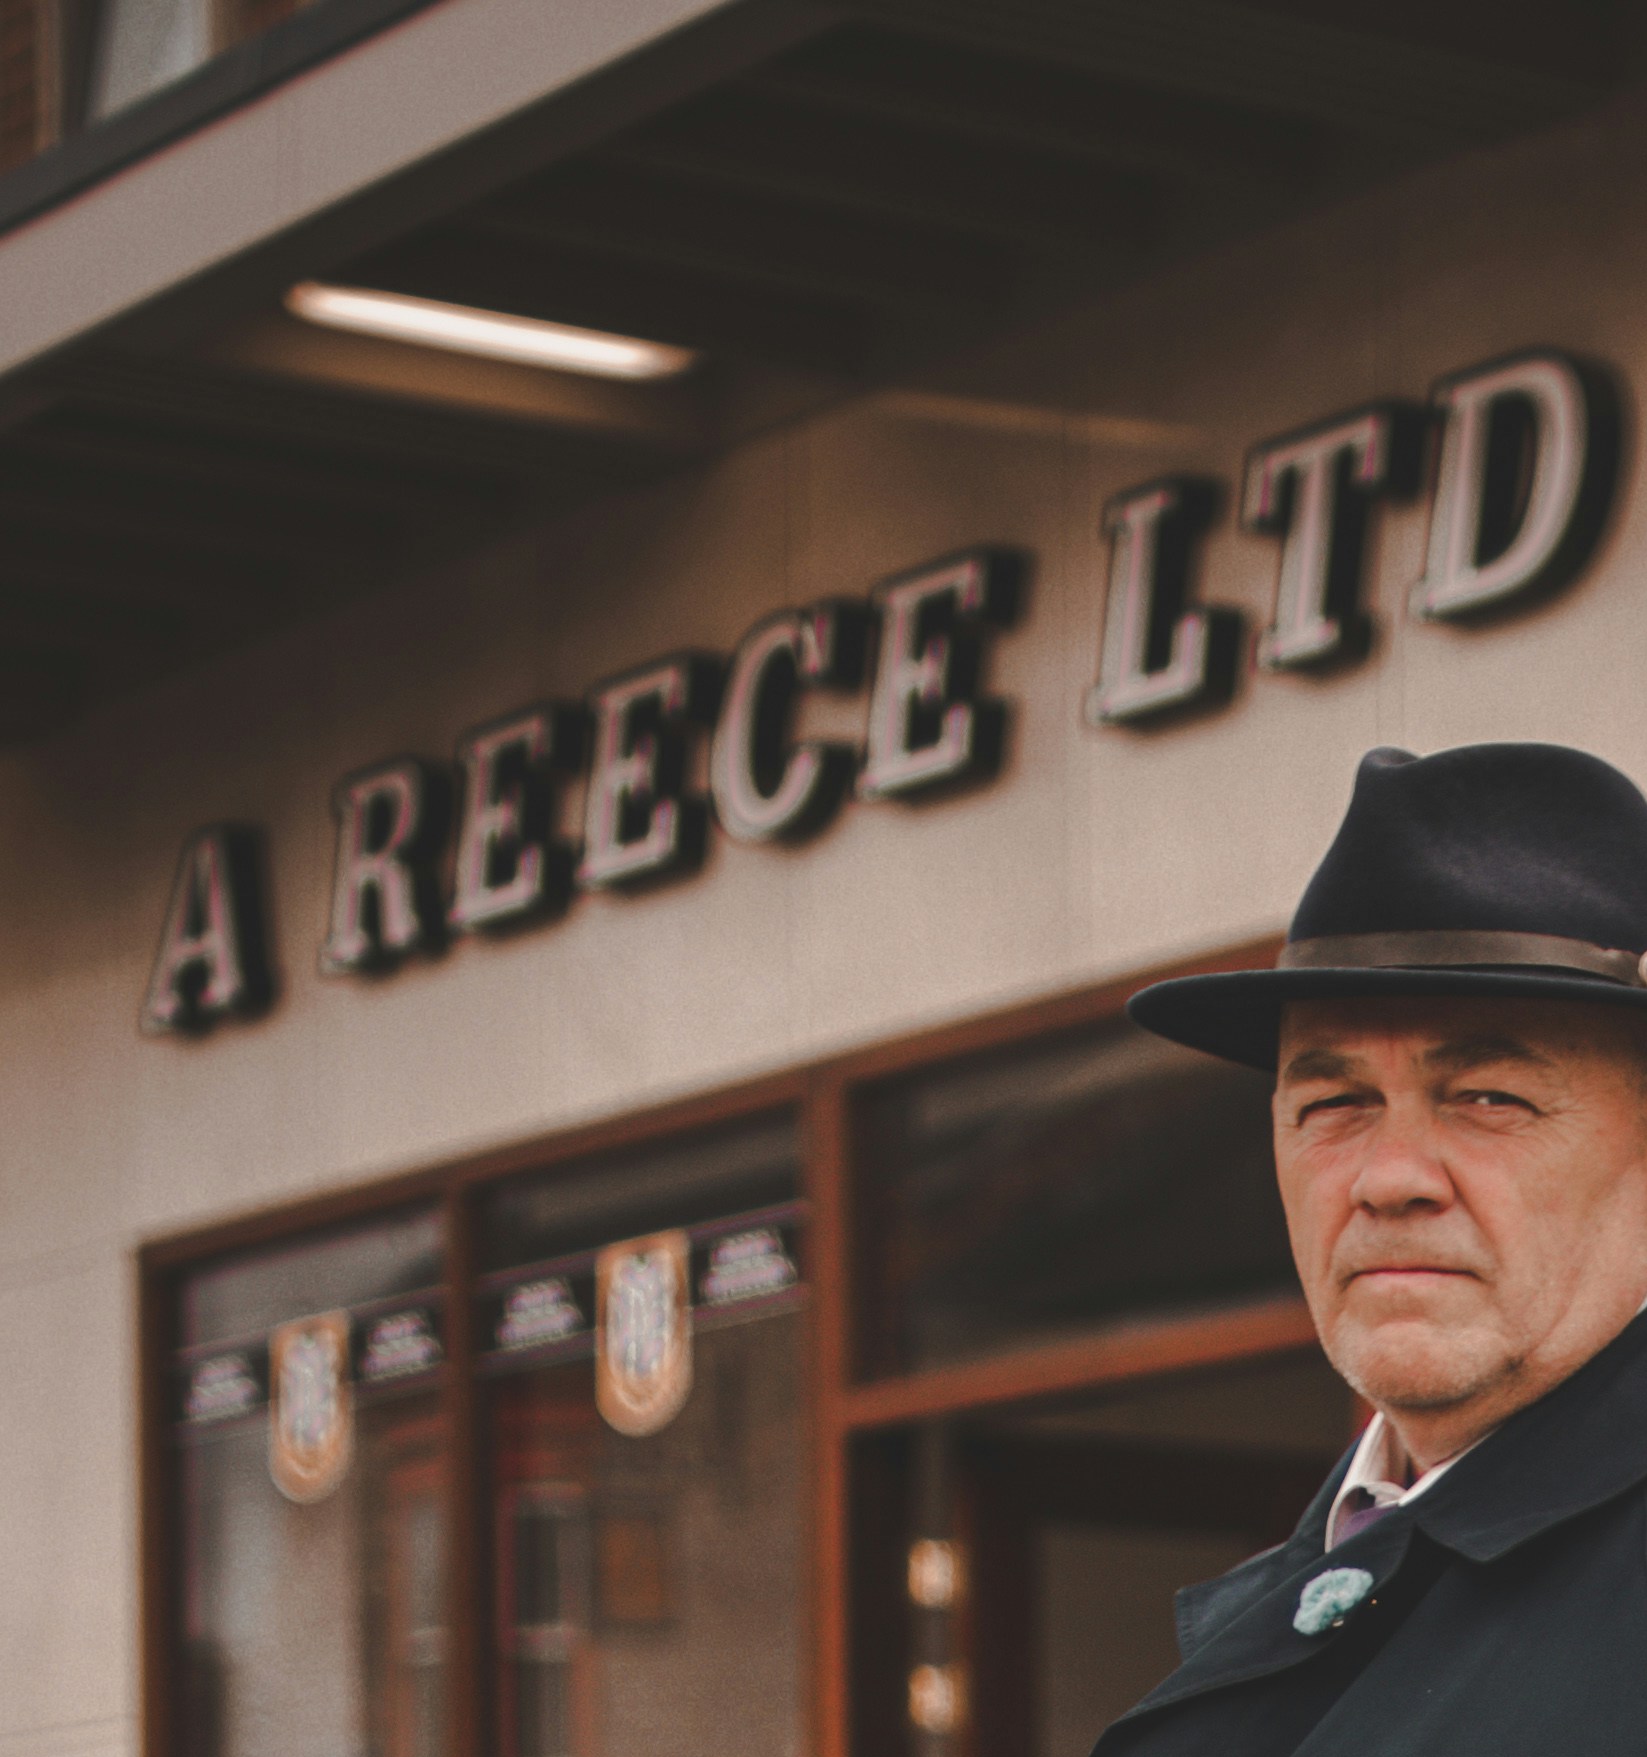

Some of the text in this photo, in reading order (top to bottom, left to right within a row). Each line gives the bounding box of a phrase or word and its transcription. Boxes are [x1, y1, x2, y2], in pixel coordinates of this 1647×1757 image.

[142, 347, 1624, 1035] A REECE LTD
